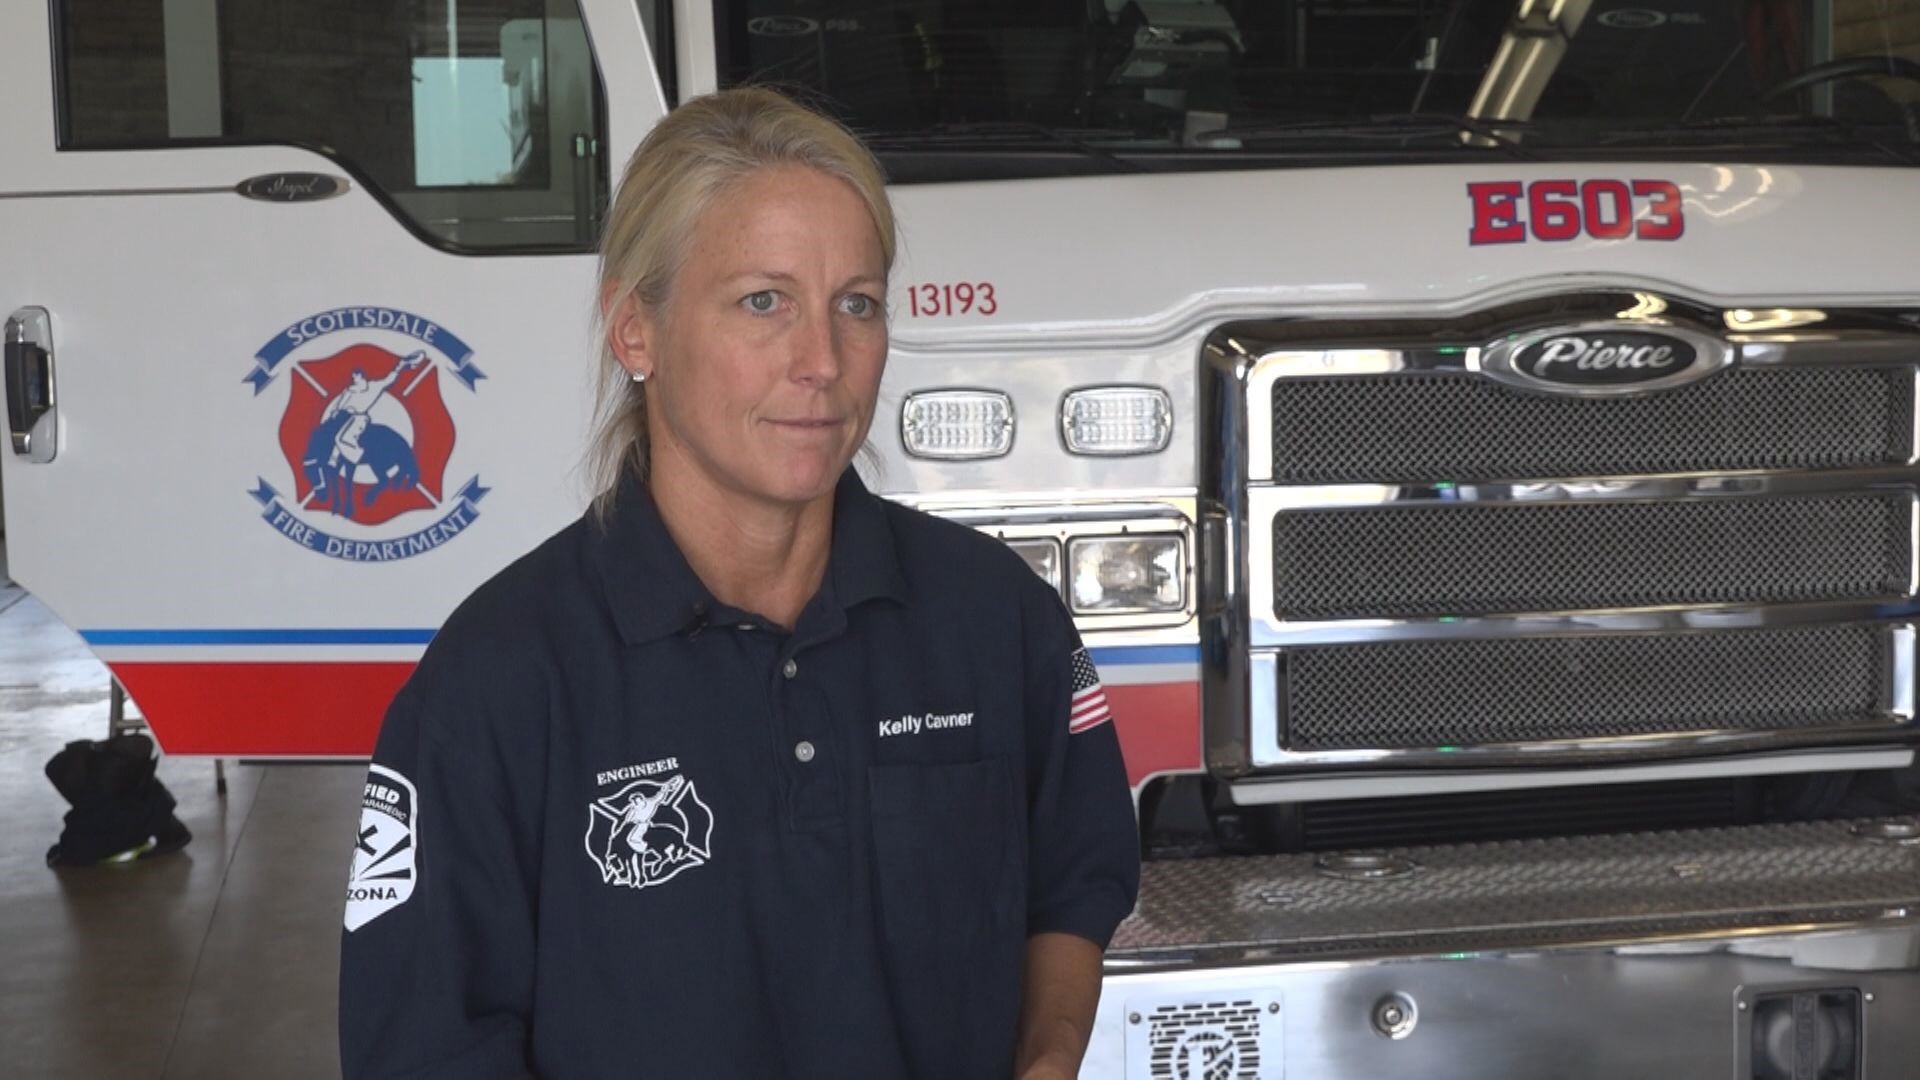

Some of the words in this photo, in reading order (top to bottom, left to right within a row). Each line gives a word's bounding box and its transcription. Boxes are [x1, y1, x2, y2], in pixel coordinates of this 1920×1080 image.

[1466, 179, 1685, 246] E603
[907, 282, 998, 318] 13193
[286, 307, 438, 346] SCOTTSDALE
[1533, 337, 1674, 376] Pierce
[272, 510, 315, 547] FIRE
[325, 508, 469, 561] DEPARTMENT
[879, 714, 922, 737] Kelly
[925, 712, 974, 729] Cavner
[596, 757, 679, 786] ENGINEER
